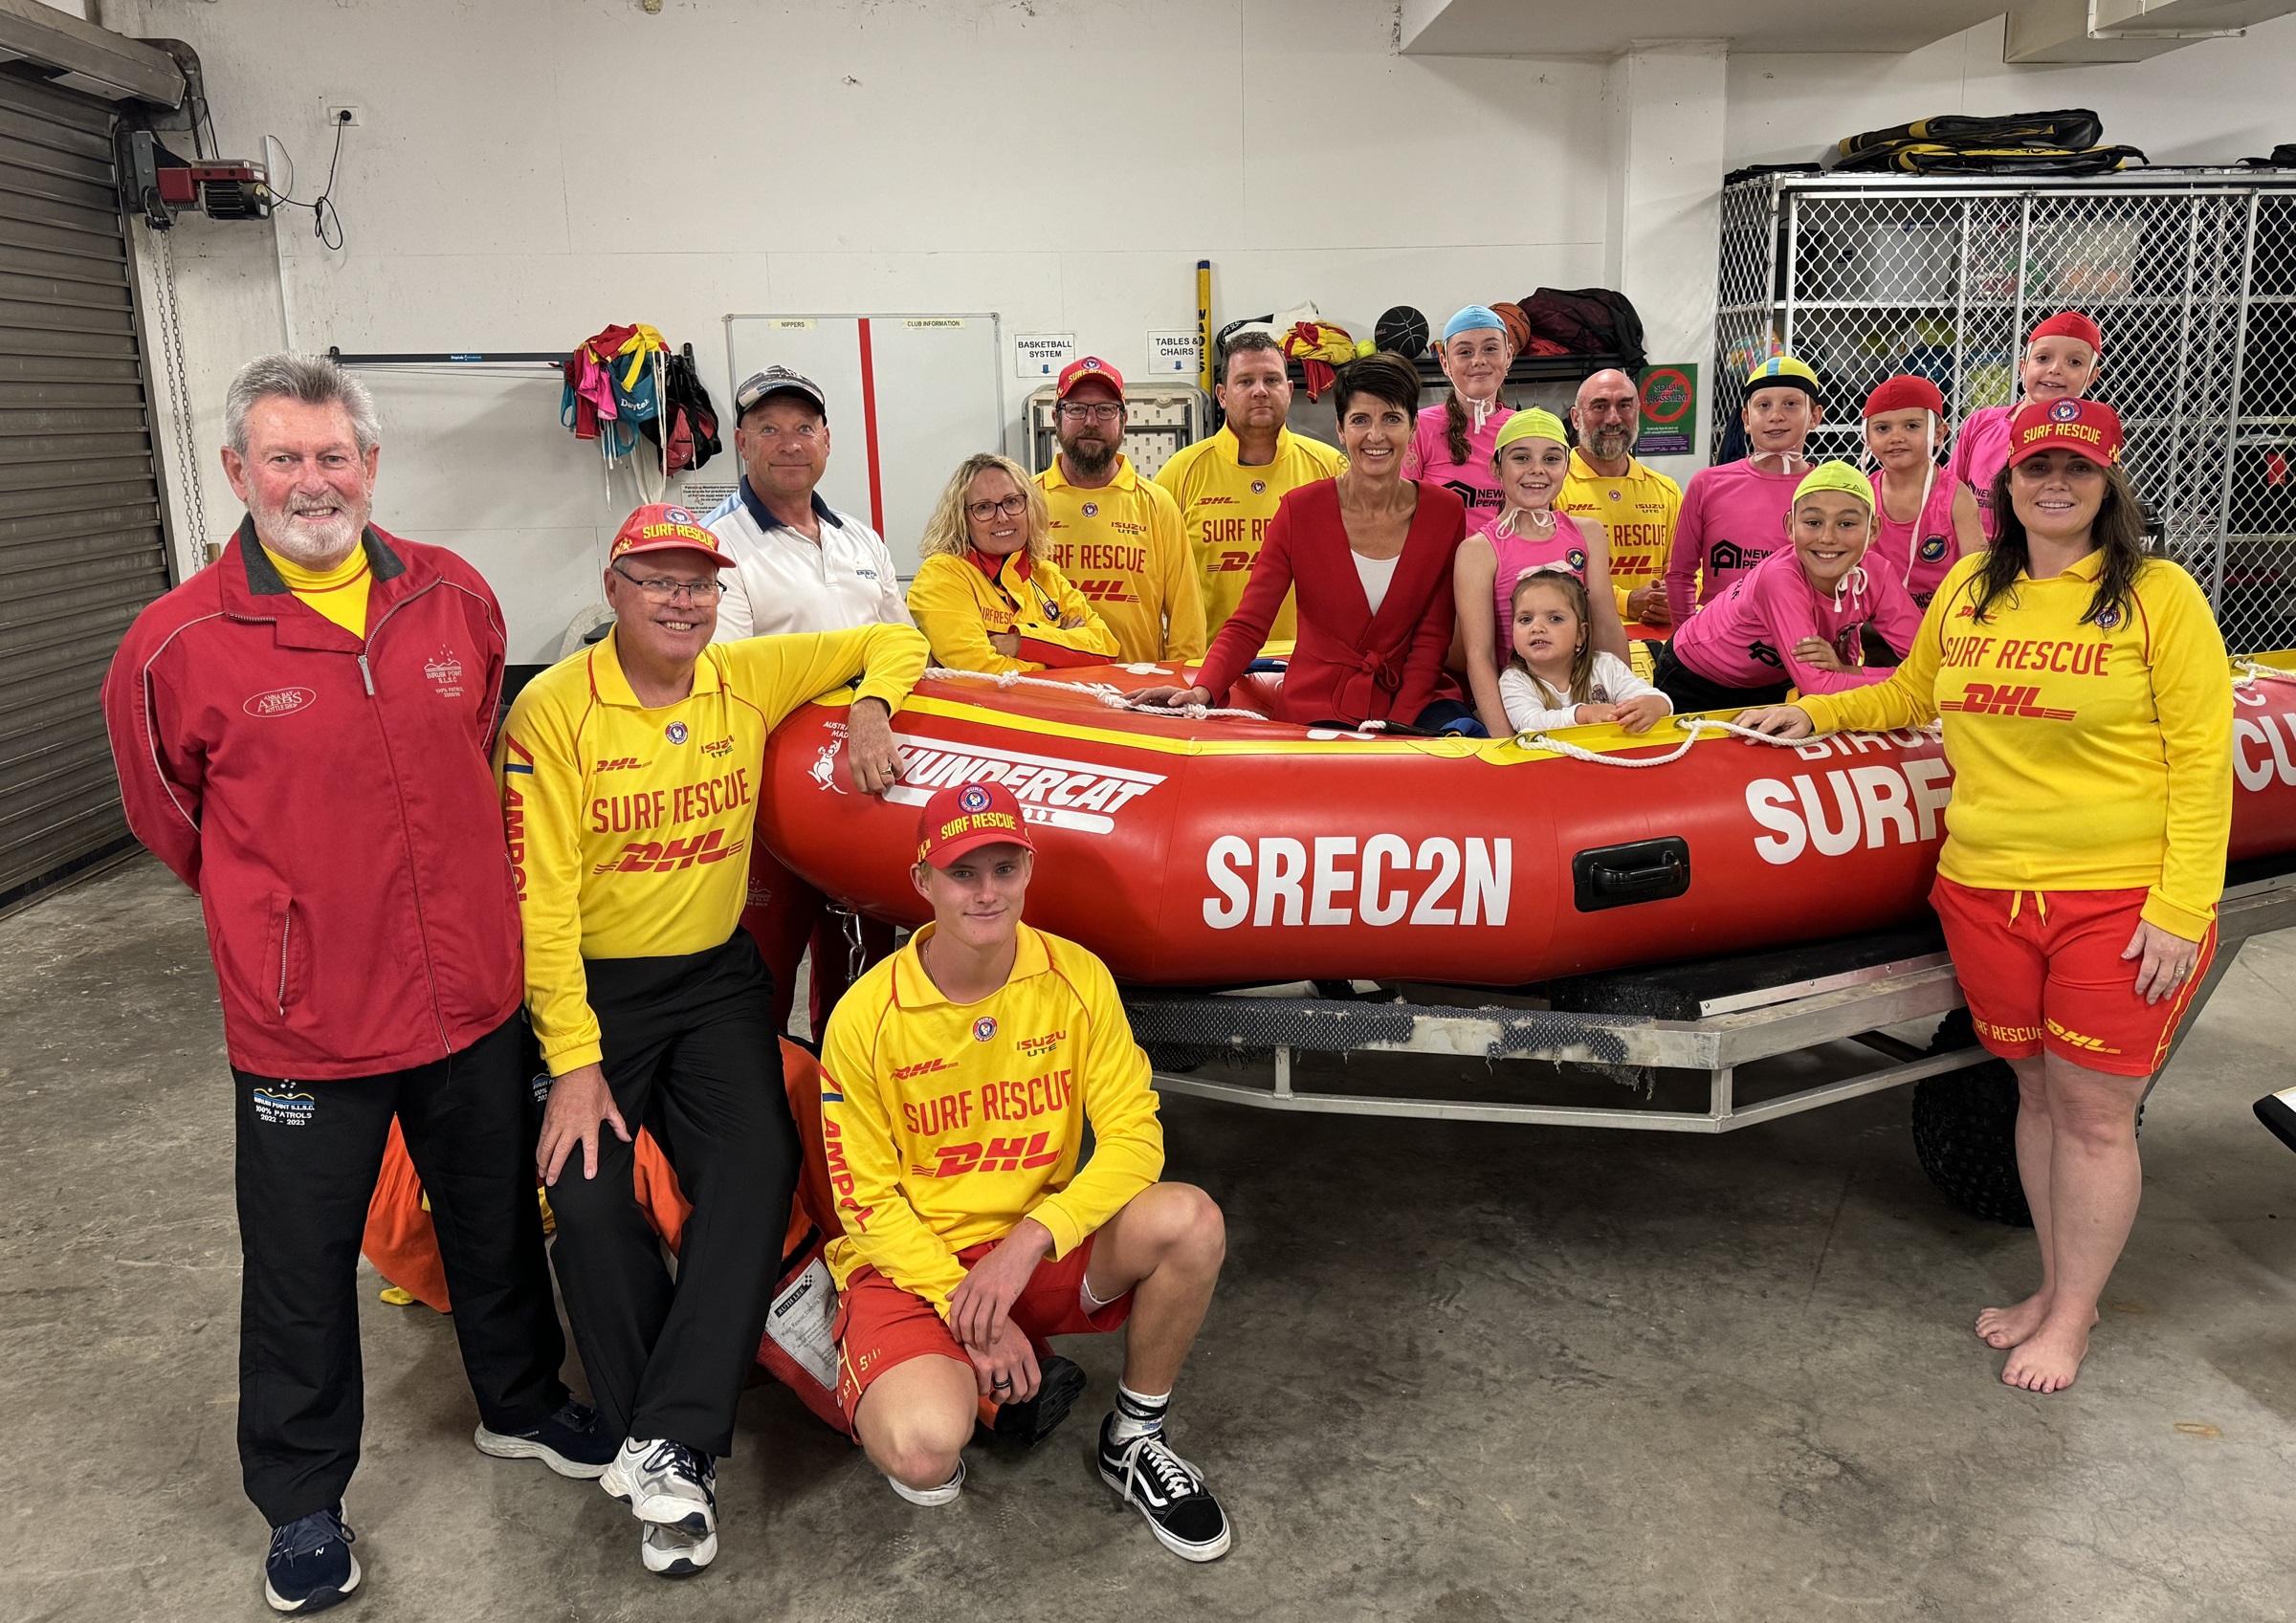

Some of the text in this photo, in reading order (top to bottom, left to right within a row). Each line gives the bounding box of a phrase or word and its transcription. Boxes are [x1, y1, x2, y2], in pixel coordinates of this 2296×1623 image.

[1017, 340, 1072, 349] BASKETBALL
[1155, 337, 1199, 346] TABLES &
[1159, 347, 1194, 357] CHAIRS
[2023, 423, 2102, 446] SURF RESCUE
[1200, 496, 1234, 506] DHL
[643, 523, 716, 551] SURF RESCUE
[1111, 521, 1147, 532] ISUZU
[1203, 517, 1247, 543] SURF
[1613, 523, 1667, 547] RESCUE
[1049, 543, 1146, 574] RF RESCUE
[1609, 556, 1653, 576] HL
[1068, 580, 1129, 602] HL
[1940, 636, 2113, 676] SURF RESCUE
[1961, 683, 2046, 718] DHL
[830, 730, 850, 738] MAD
[596, 757, 642, 773] DHL
[896, 746, 1154, 814] HUNDERCAT
[591, 767, 751, 834] SURF RESCUE
[1745, 757, 1952, 866] SURF
[940, 812, 1017, 840] SURF RESCUE
[614, 827, 731, 873] DHL
[1203, 833, 1512, 930] SREC2N
[1016, 1030, 1067, 1051] ISUZU
[1992, 1024, 2043, 1042] RESCUE
[2046, 1018, 2107, 1053] DHL
[1027, 1042, 1057, 1058] UTE
[895, 1058, 948, 1081] DHL
[255, 1105, 313, 1119] 100% PATROLS
[272, 1102, 290, 1110] POINT
[903, 1068, 1071, 1137] SURF RESCUE
[260, 1113, 276, 1123] 2022
[934, 1130, 1061, 1178] DHL
